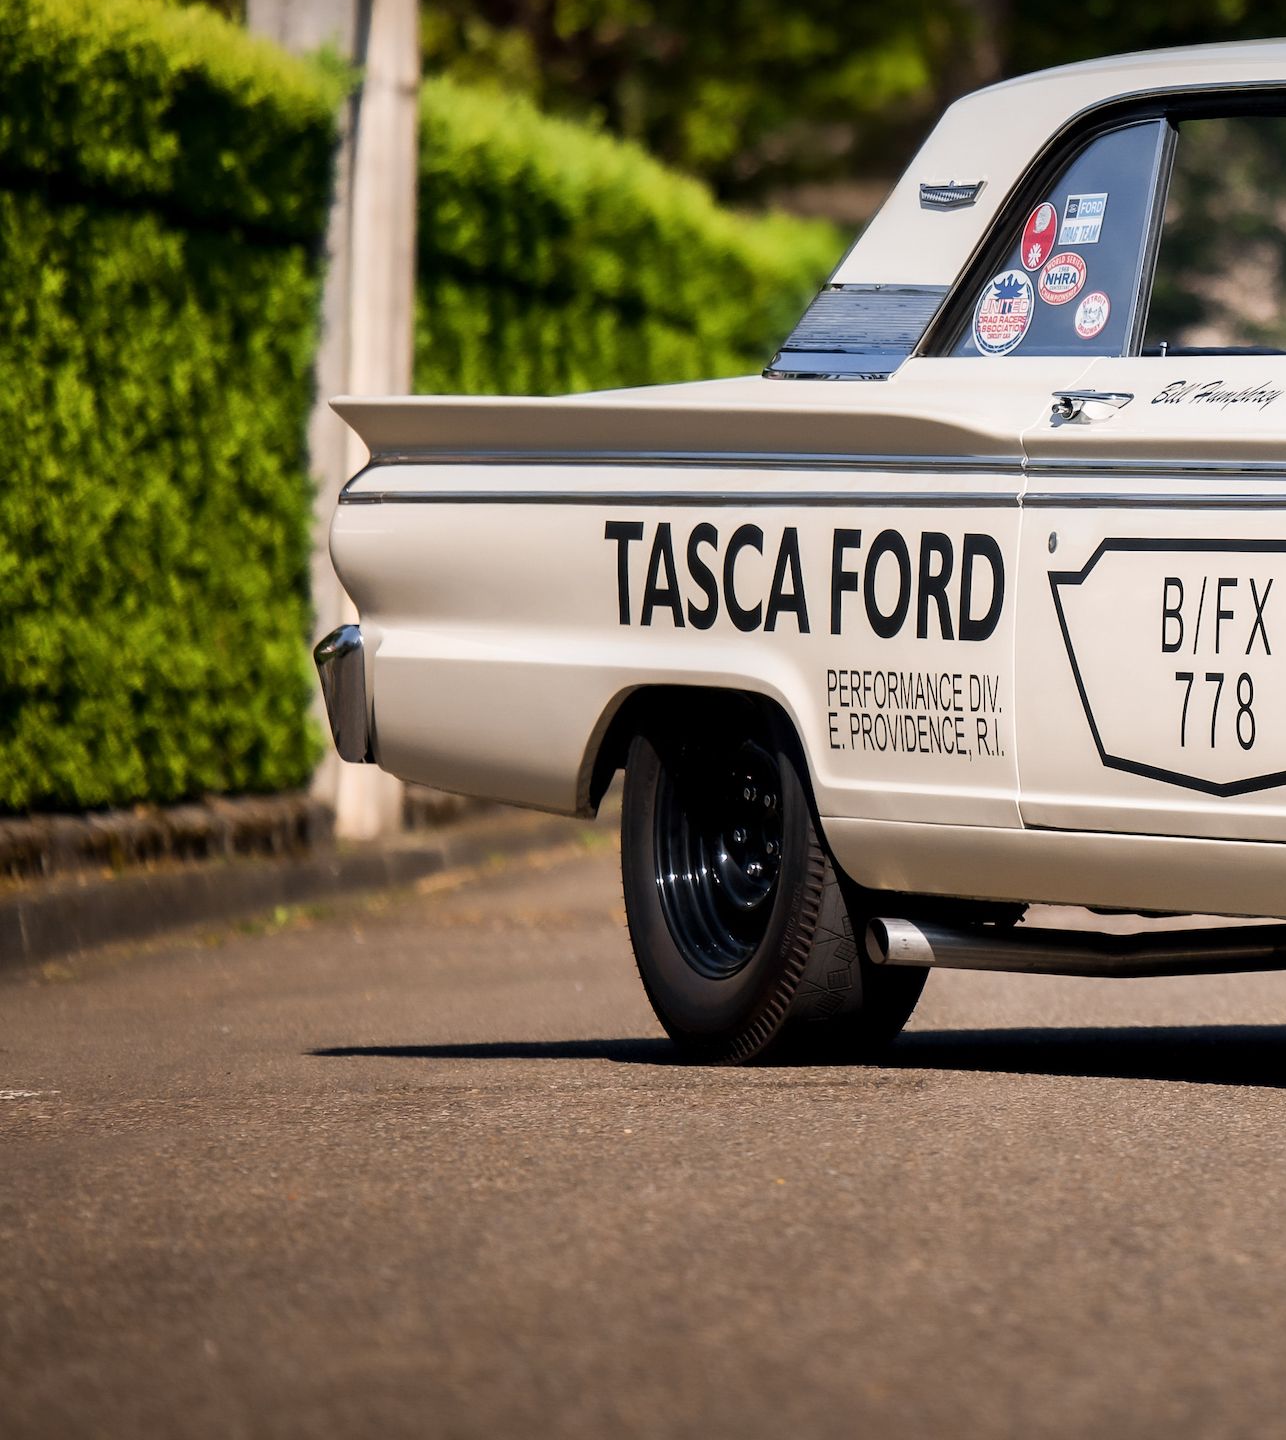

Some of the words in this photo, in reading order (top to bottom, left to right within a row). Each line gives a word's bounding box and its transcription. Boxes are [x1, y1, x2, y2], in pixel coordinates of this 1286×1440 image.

[1080, 200, 1103, 214] FORD
[1045, 272, 1077, 285] NHRA
[980, 298, 1029, 314] UNITED
[977, 325, 1026, 333] ASSOCIATION
[1151, 380, 1202, 404] Bill
[604, 520, 810, 634] TASCA
[830, 528, 1005, 642] FORD
[1161, 576, 1274, 656] B/FX
[827, 669, 963, 712] PERFORMANCE
[969, 675, 1002, 714] DIV.
[1175, 672, 1256, 751] 778
[829, 712, 846, 750] E.
[851, 713, 973, 762] PROVIDENCE,
[978, 719, 1005, 757] R.I.
